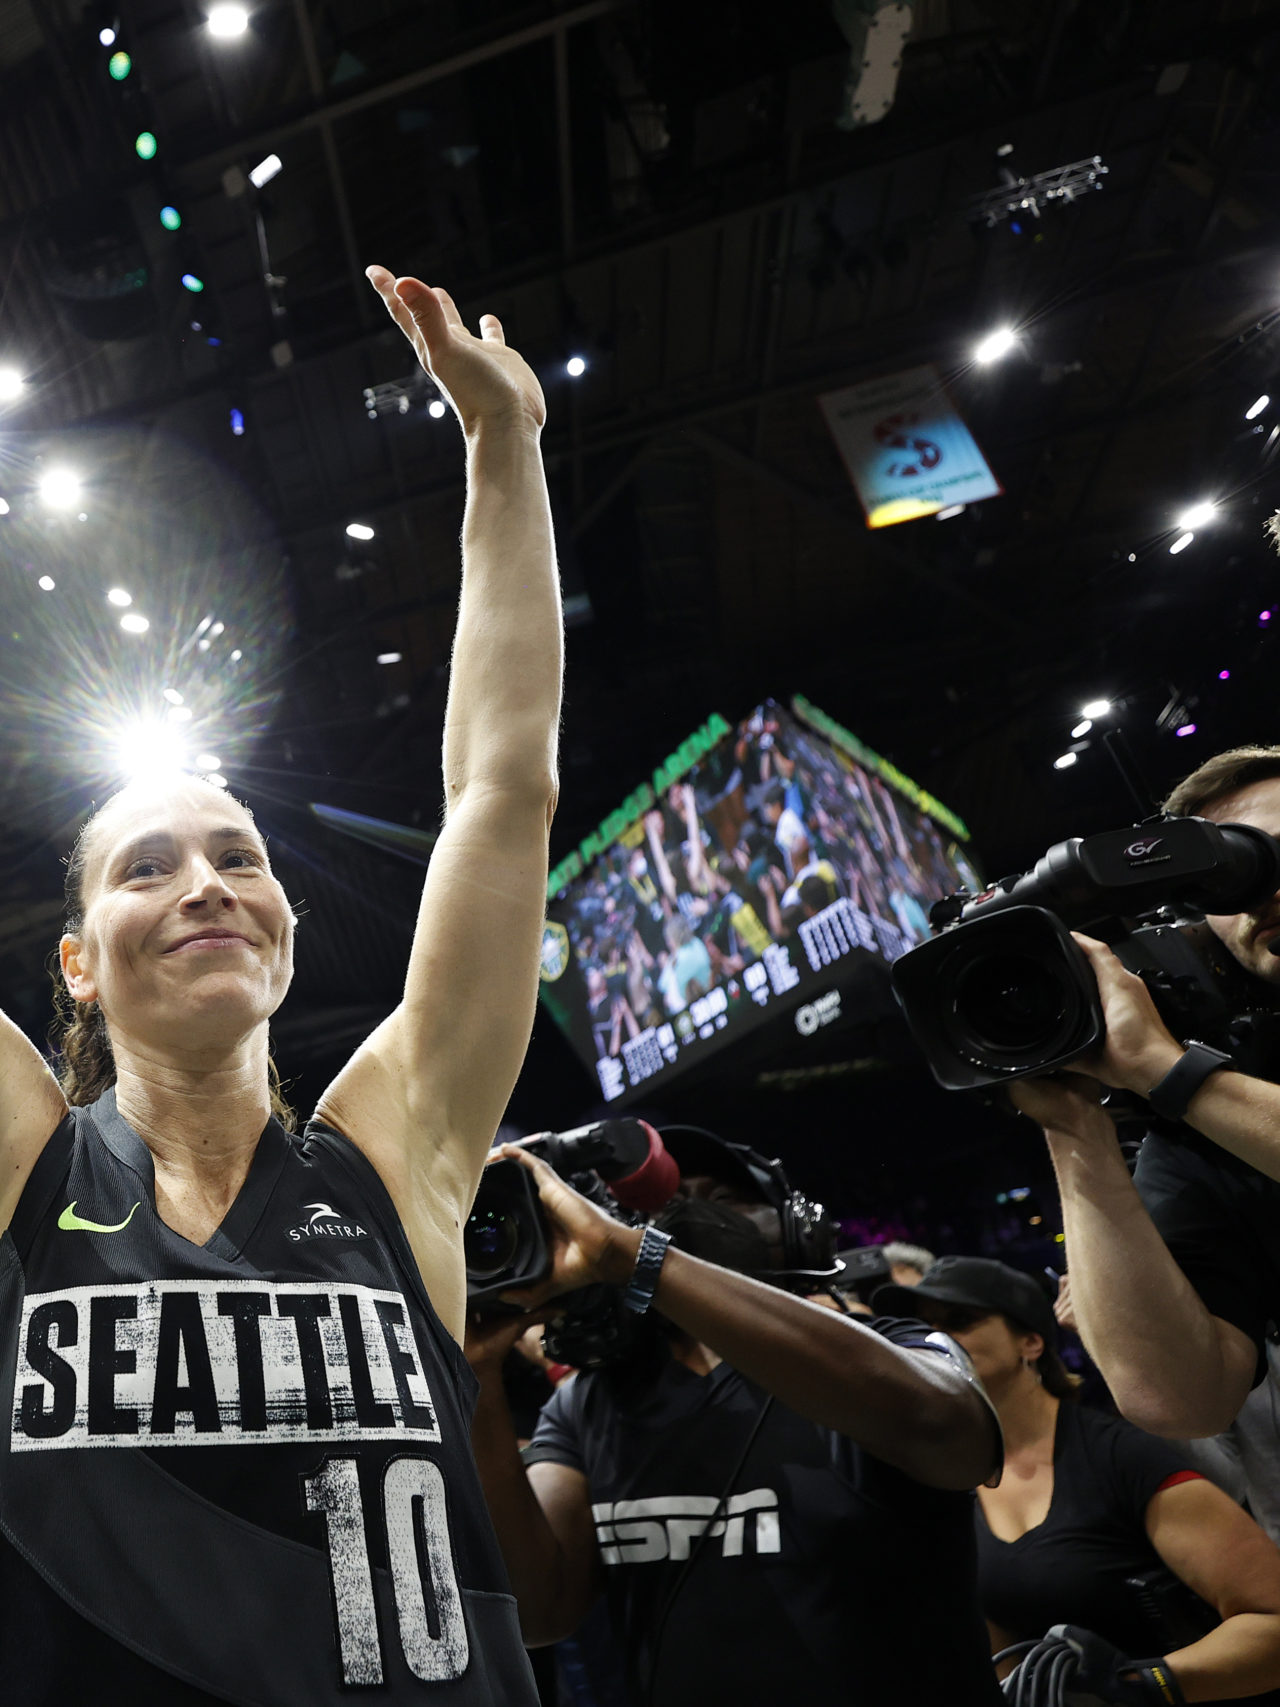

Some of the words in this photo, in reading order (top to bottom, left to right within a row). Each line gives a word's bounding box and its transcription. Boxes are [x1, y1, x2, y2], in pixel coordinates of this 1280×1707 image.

[289, 1224, 368, 1241] SYMETRA
[20, 1290, 434, 1440] SEATTLE
[304, 1456, 471, 1686] 10
[591, 1487, 781, 1566] ESPN
